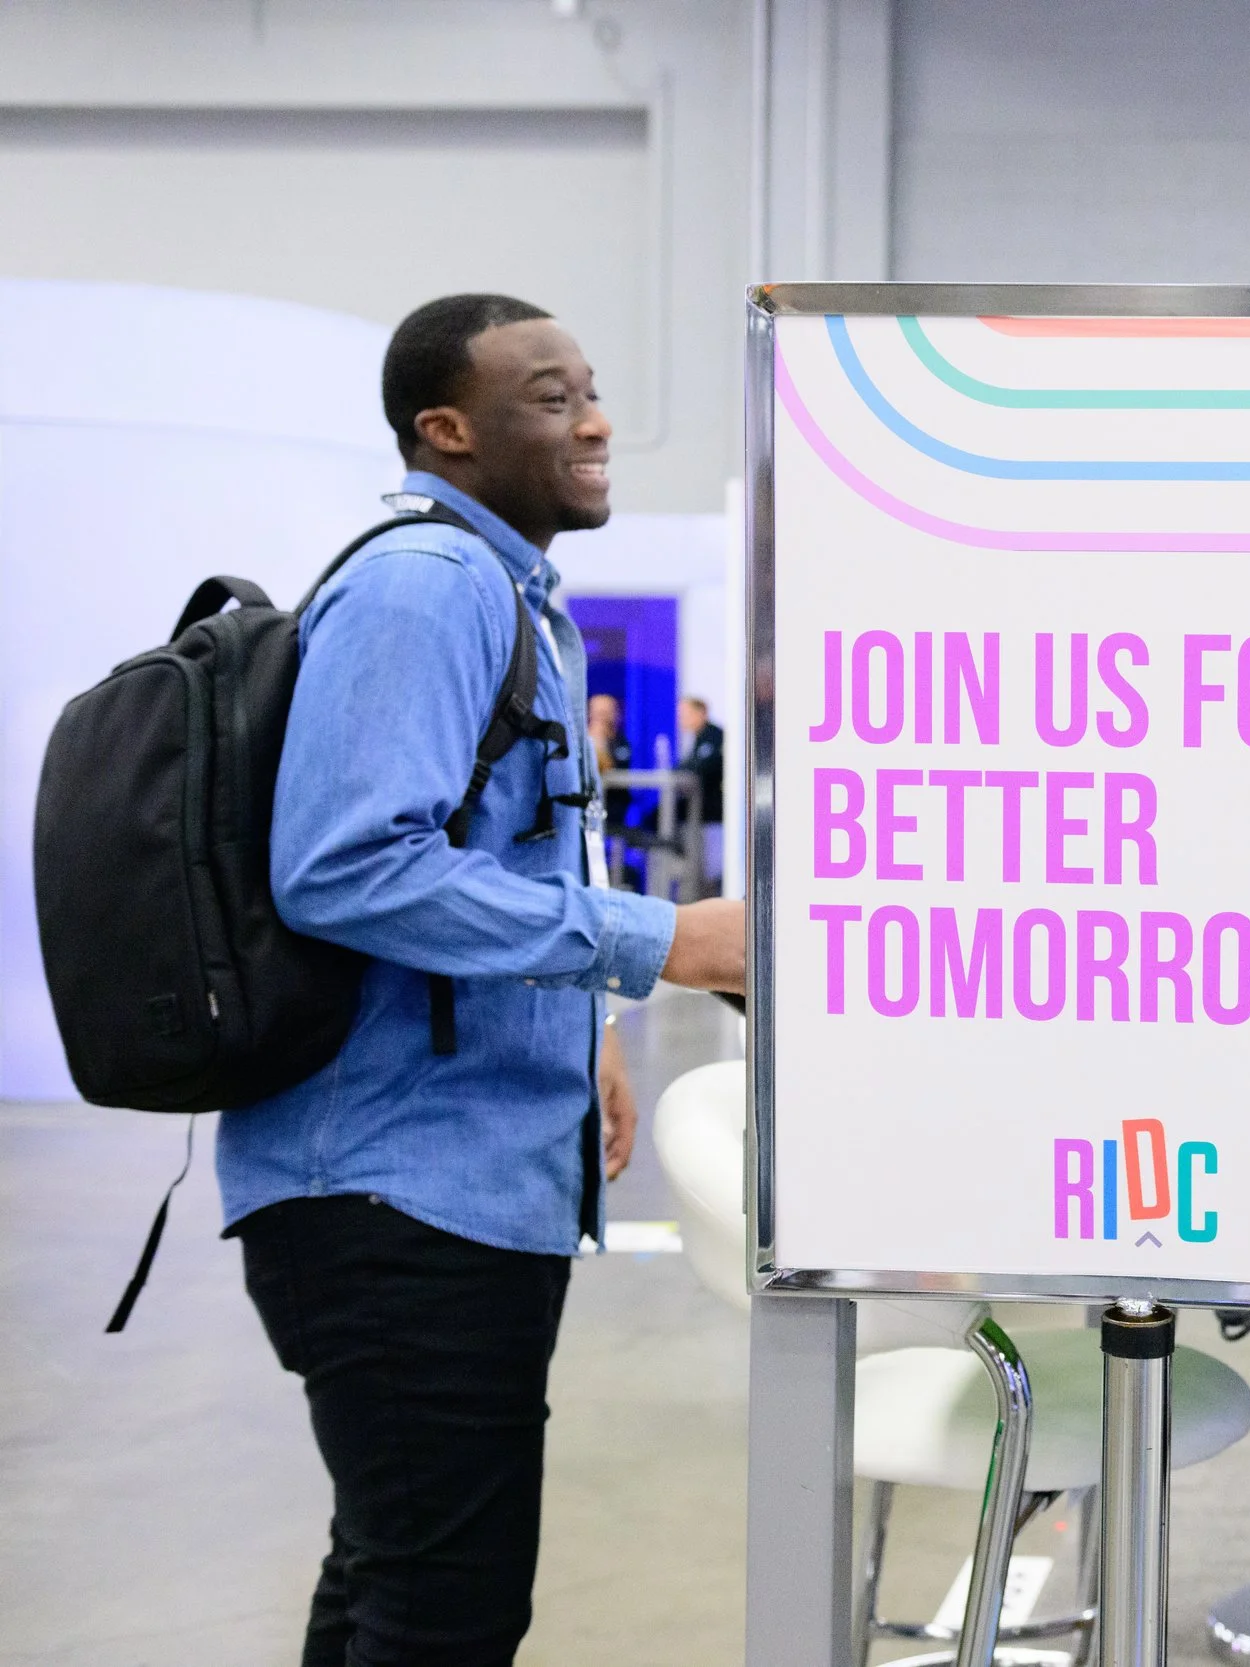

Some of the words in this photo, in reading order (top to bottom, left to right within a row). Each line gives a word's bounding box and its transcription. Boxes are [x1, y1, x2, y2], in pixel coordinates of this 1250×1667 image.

[809, 630, 1000, 745] JOIN
[1035, 632, 1150, 748] US
[814, 768, 1158, 886] BETTER
[1054, 1118, 1218, 1242] RIDC
